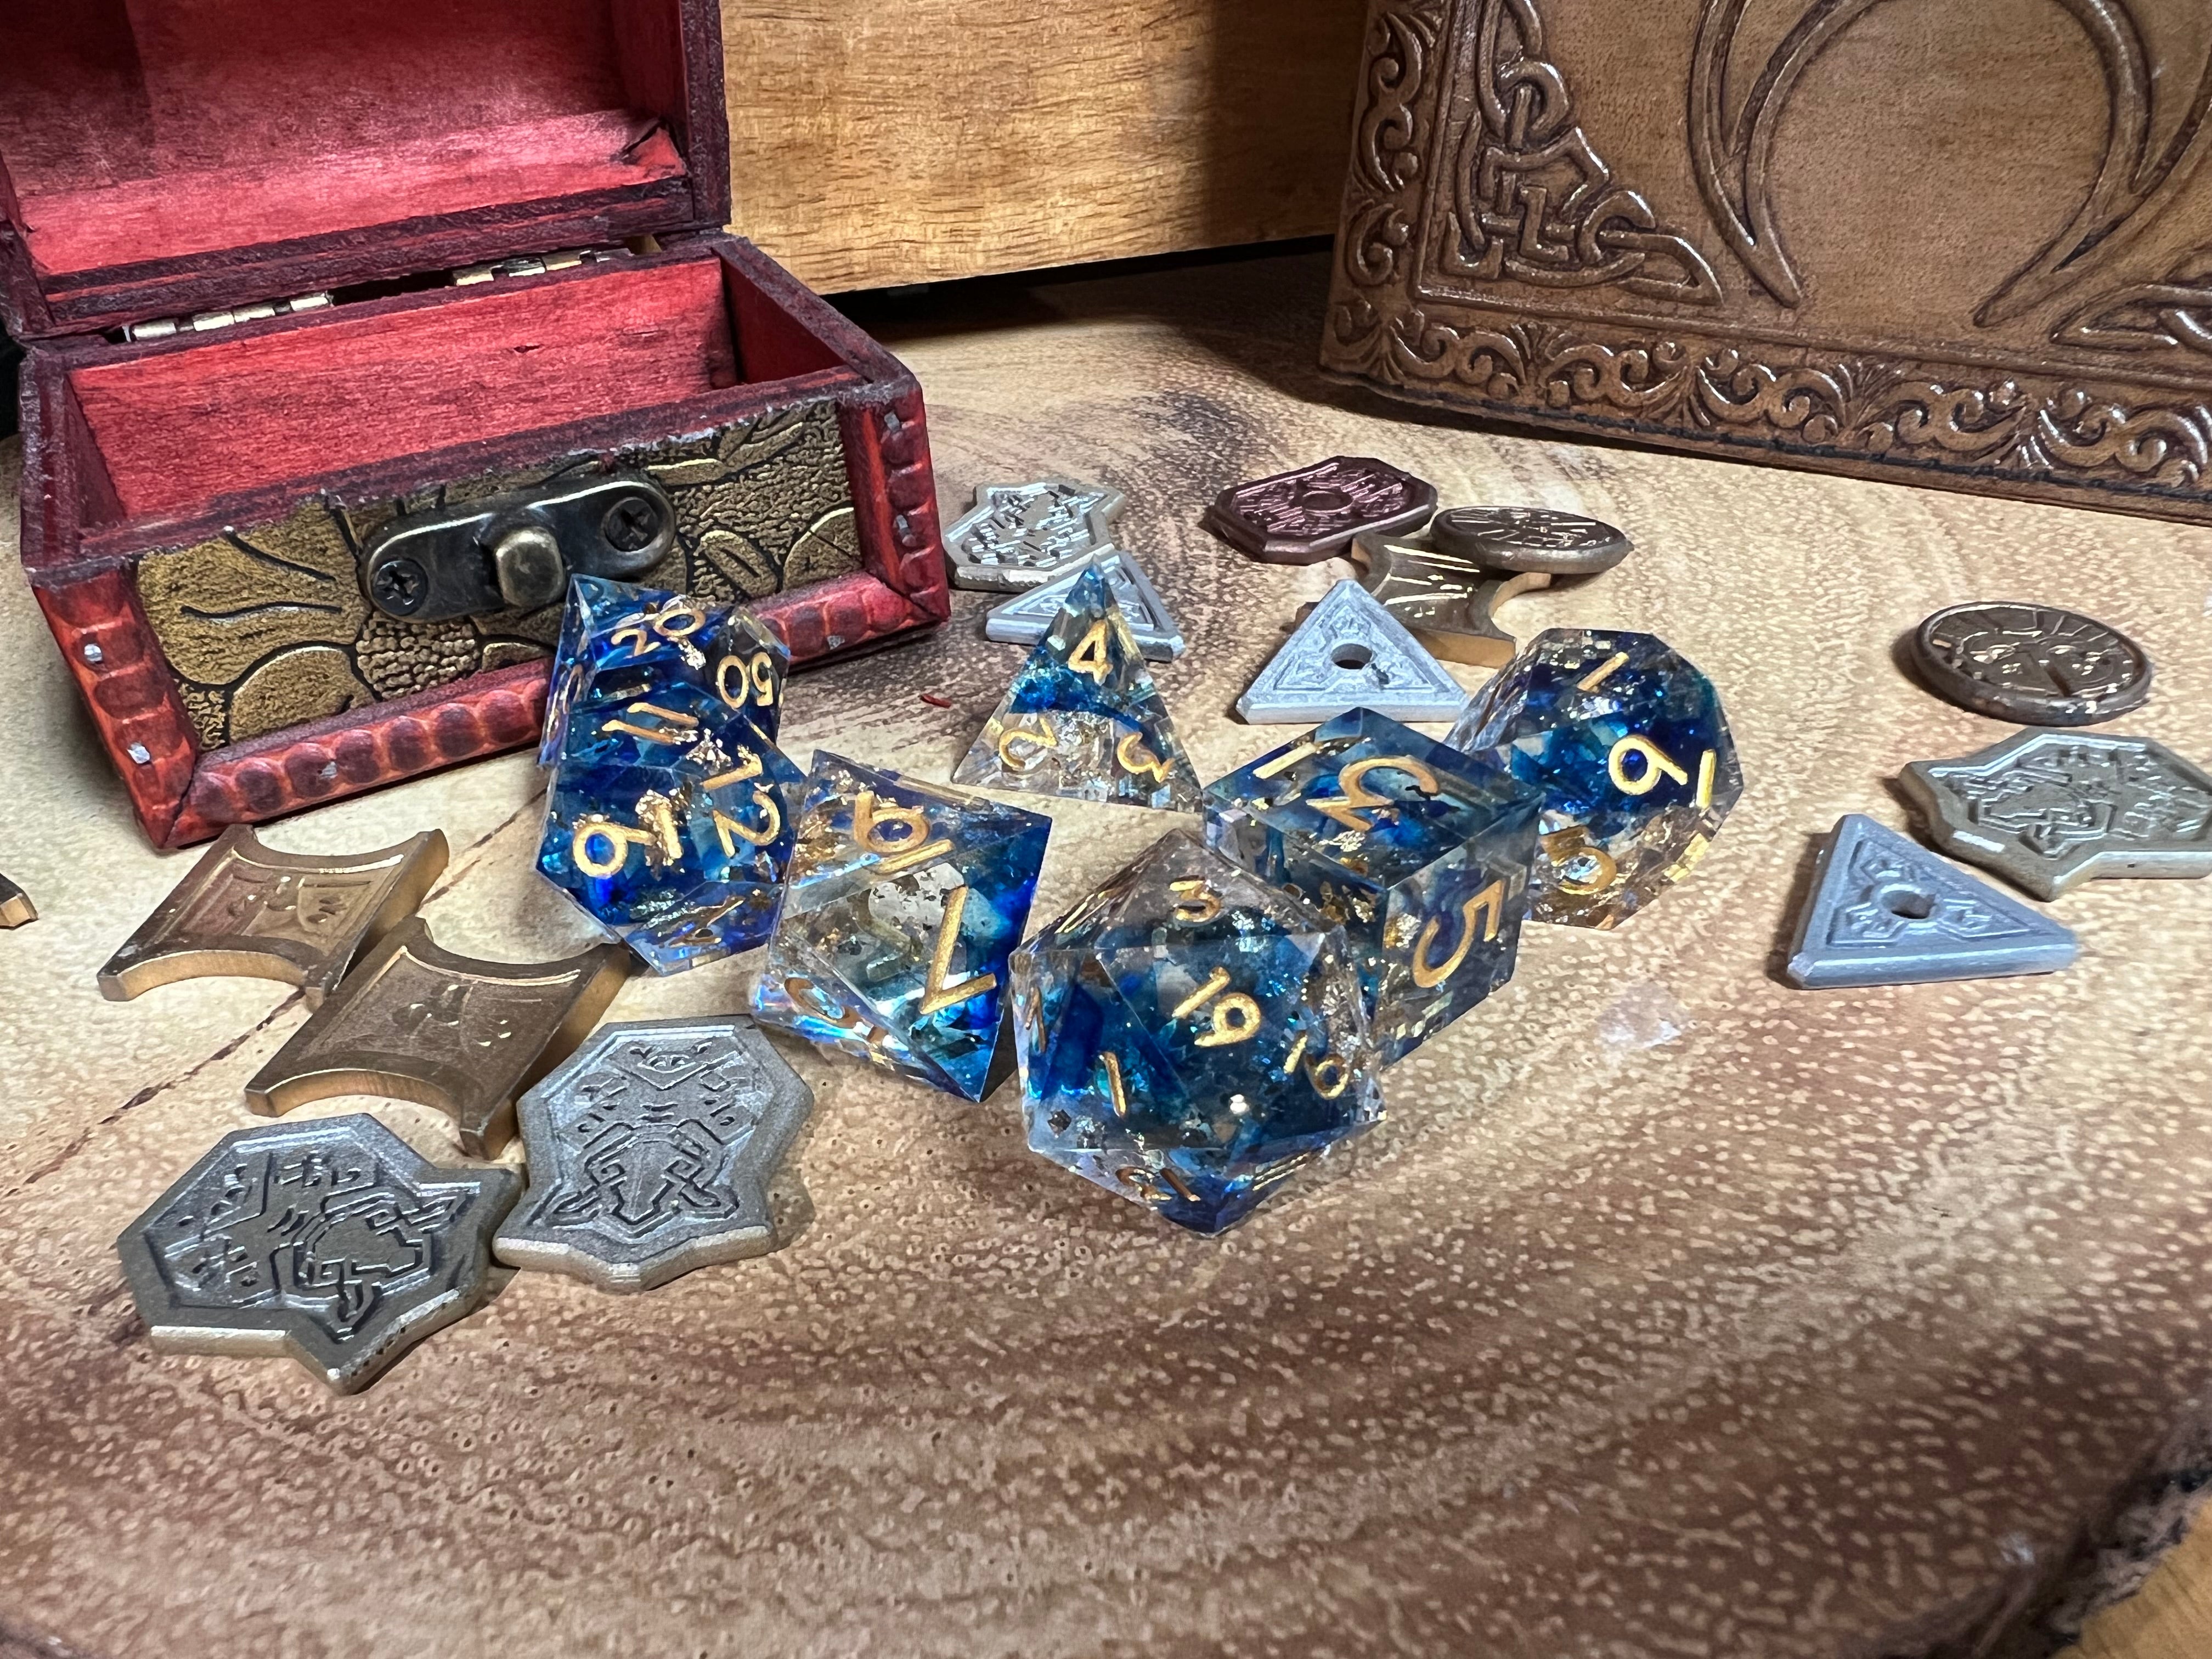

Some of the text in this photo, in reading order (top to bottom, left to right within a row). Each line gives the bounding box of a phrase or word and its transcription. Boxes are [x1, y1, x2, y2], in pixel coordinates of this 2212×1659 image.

[611, 607, 707, 657] 20
[1068, 619, 1113, 685] 4
[1172, 966, 1261, 1047] 19
